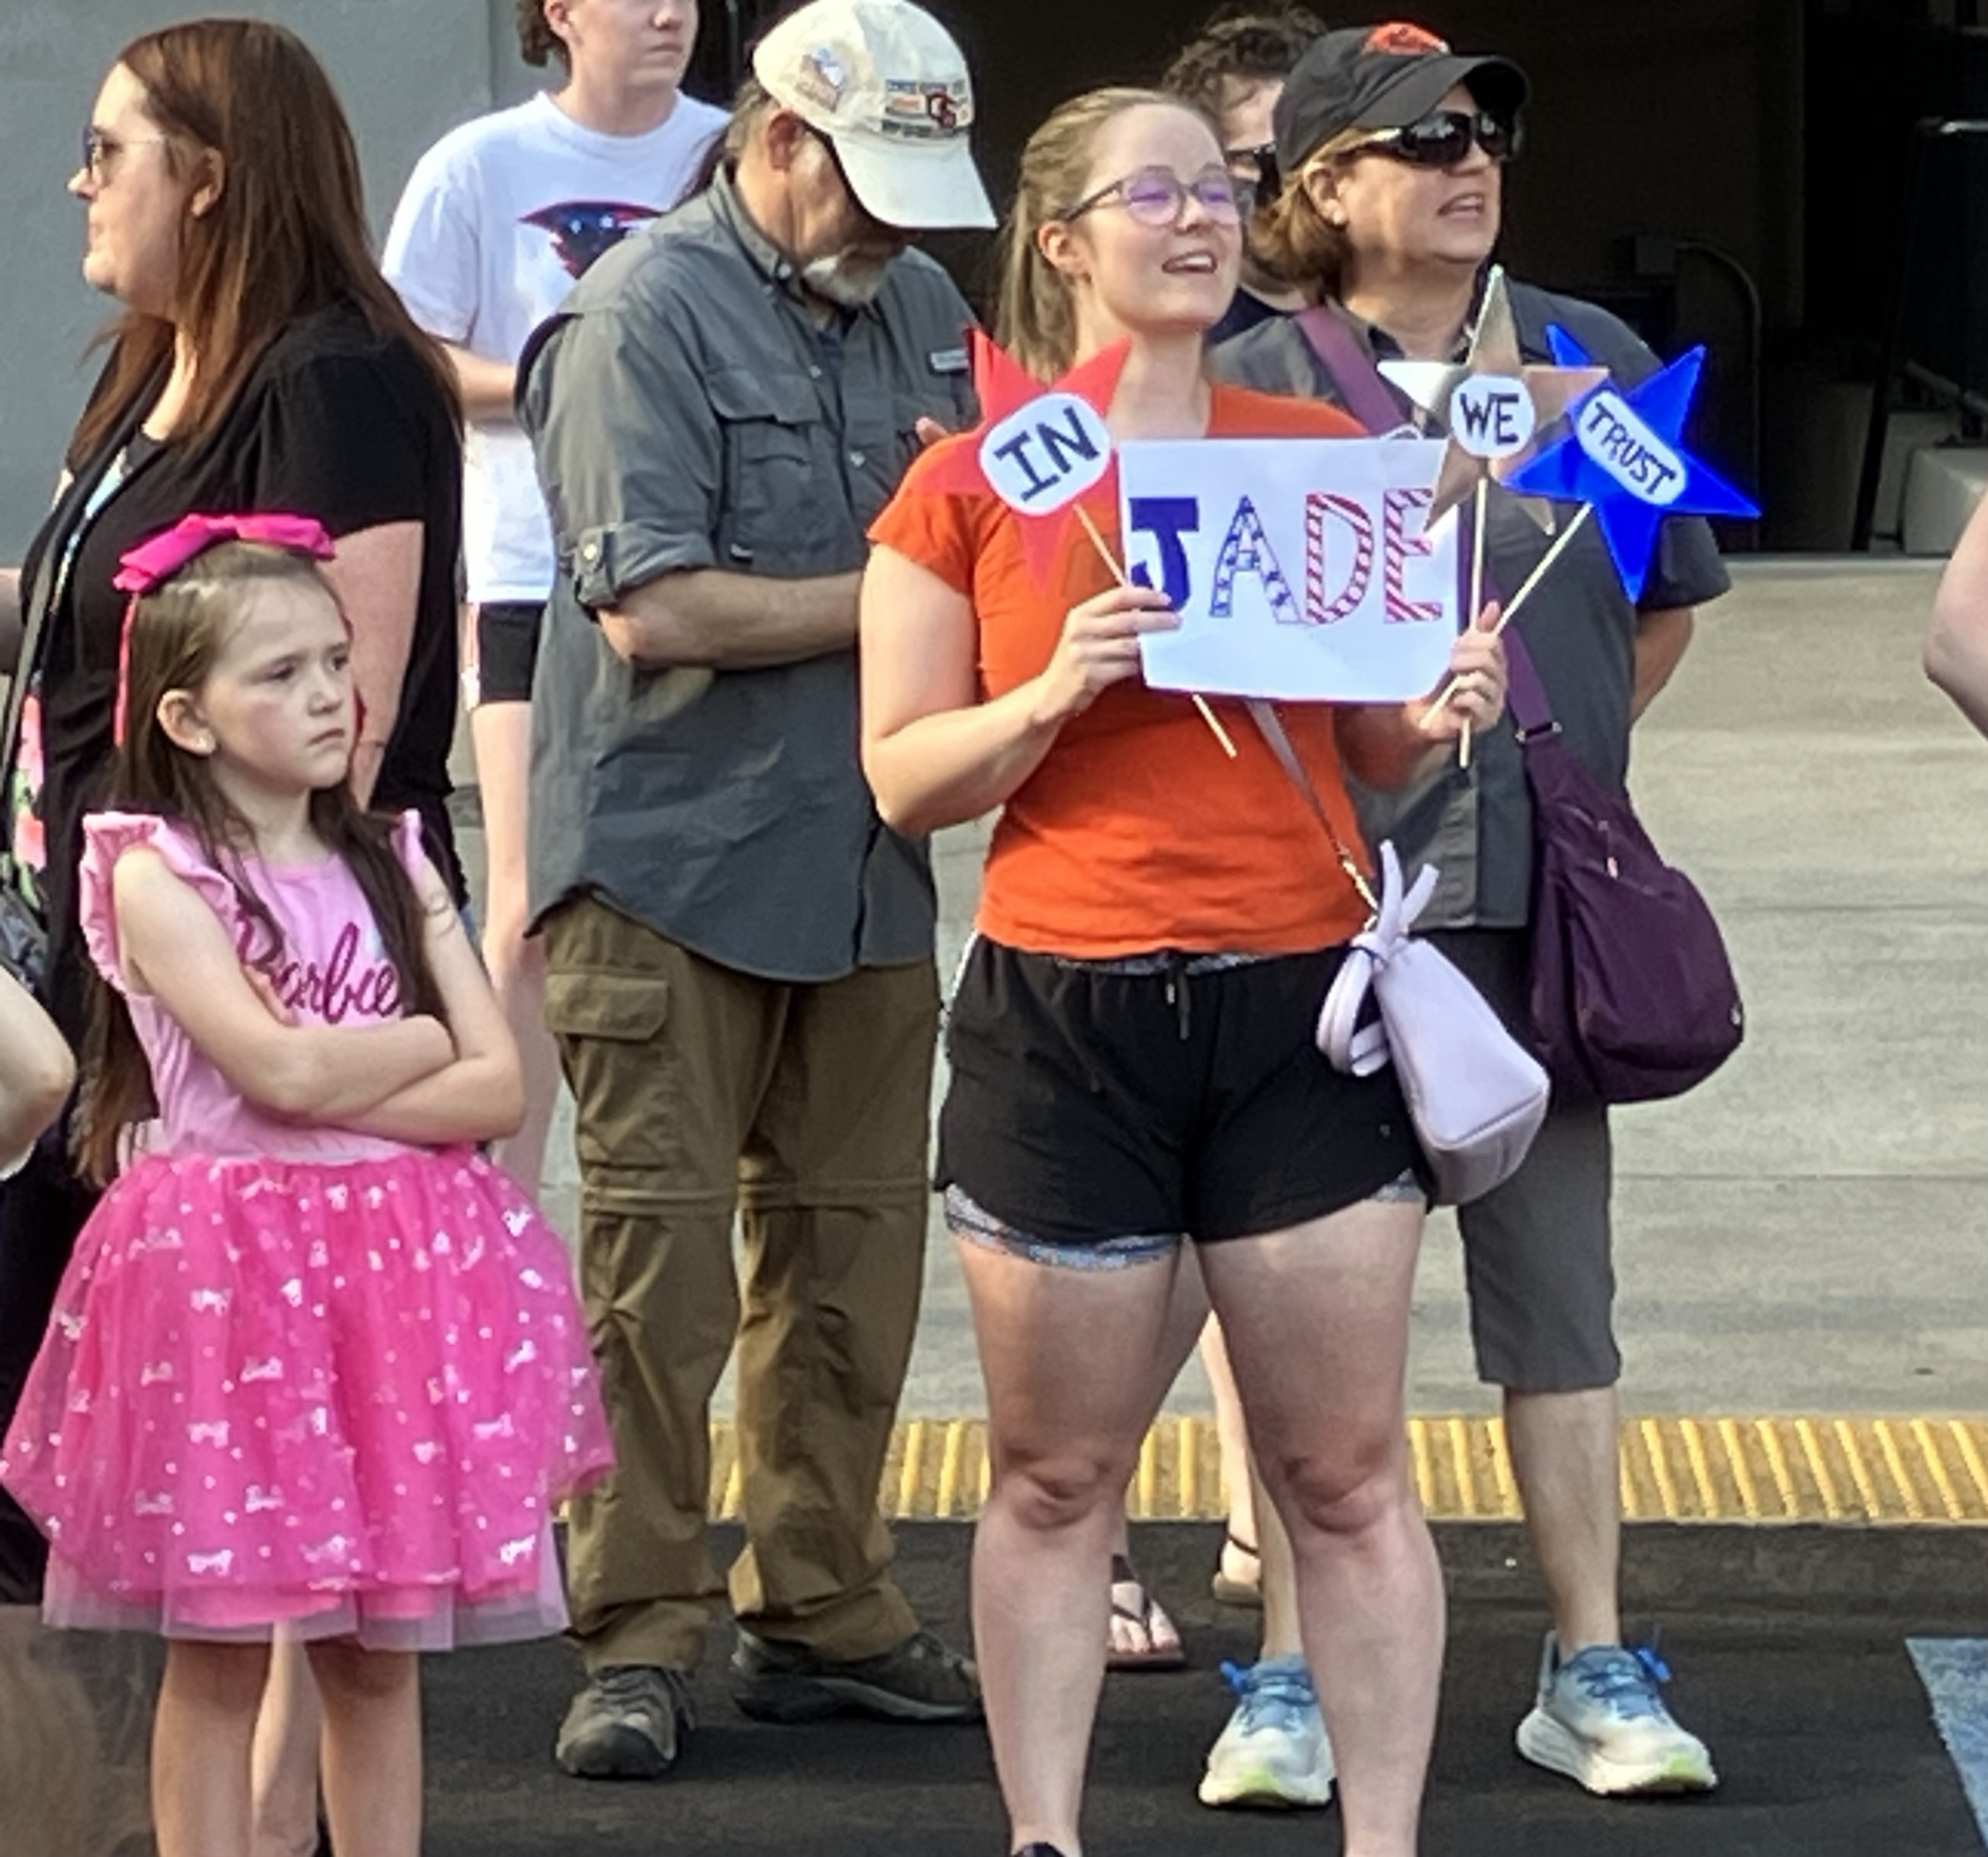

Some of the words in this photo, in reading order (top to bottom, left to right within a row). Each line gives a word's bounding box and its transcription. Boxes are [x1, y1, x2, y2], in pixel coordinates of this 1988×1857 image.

[993, 406, 1100, 502] IN
[1460, 393, 1521, 446] WE
[1586, 401, 1677, 495] TRUST
[1128, 488, 1442, 624] JADE
